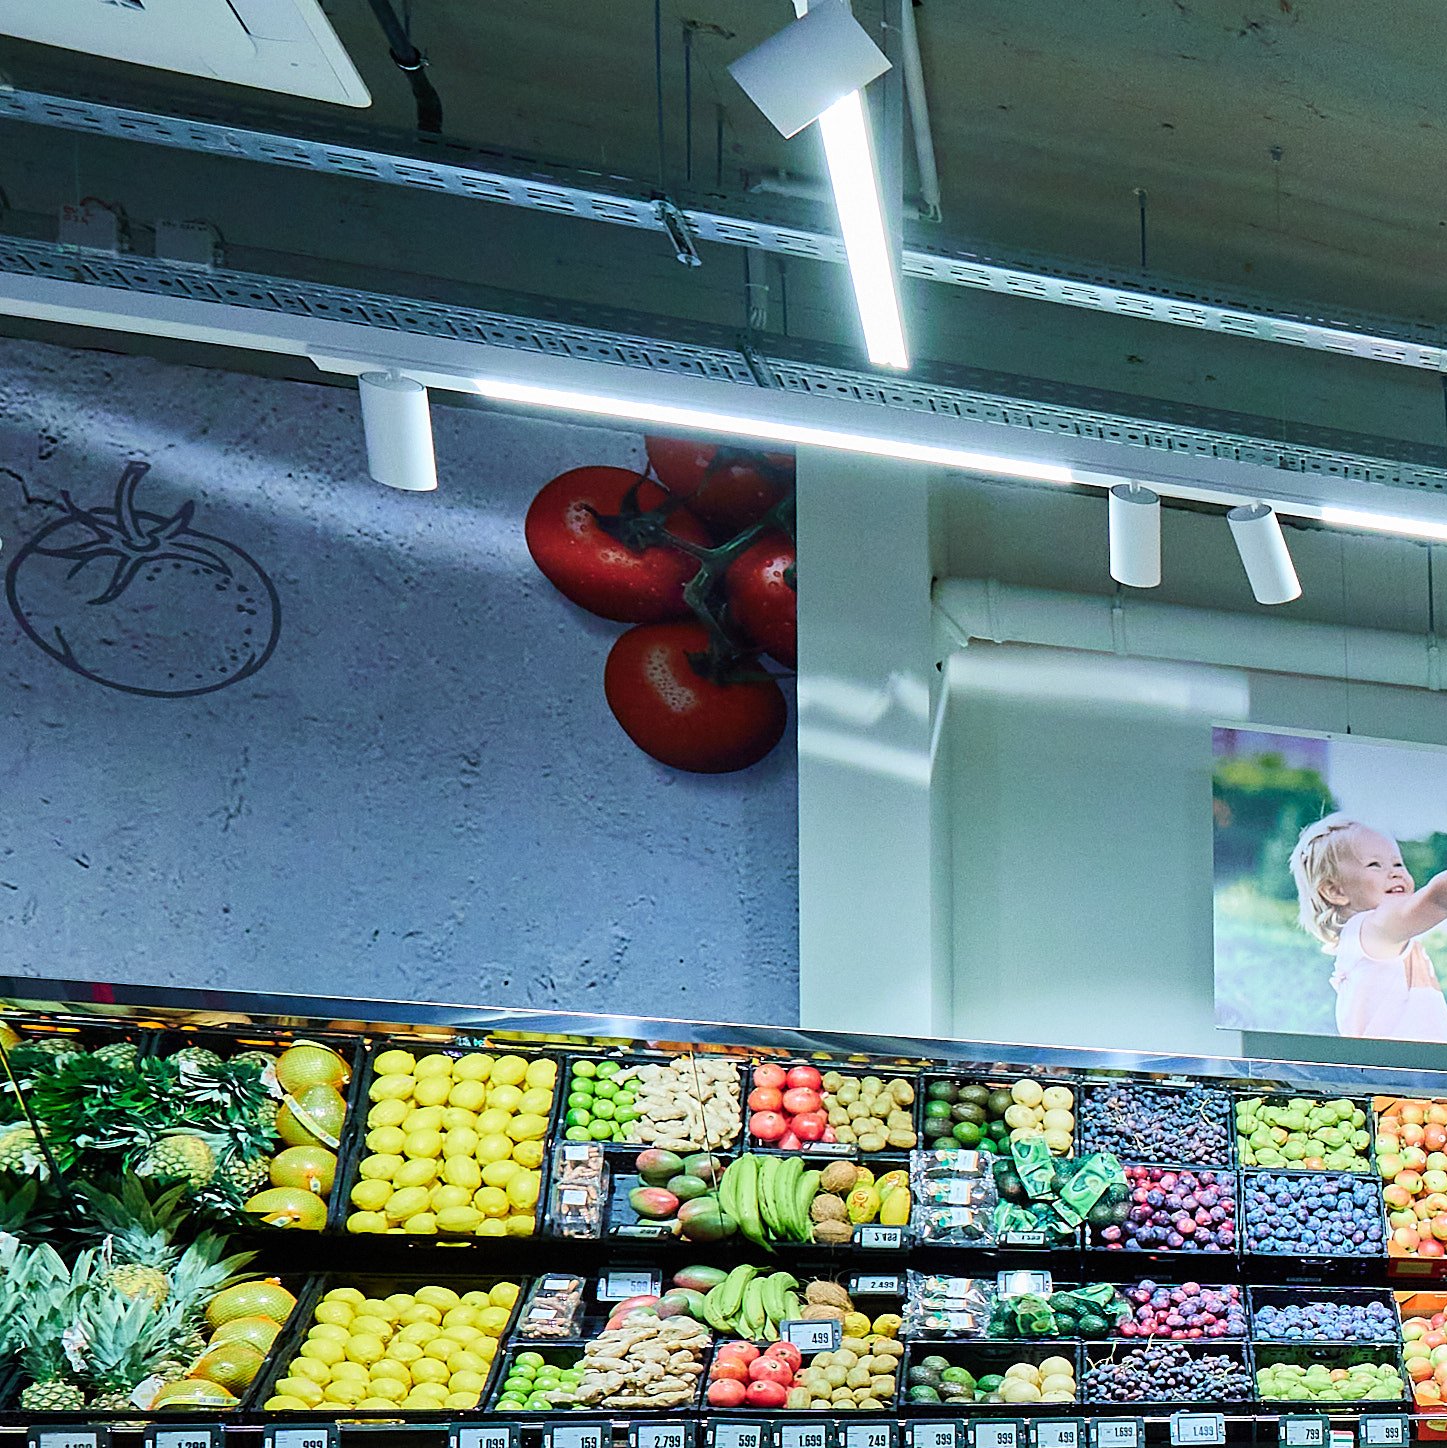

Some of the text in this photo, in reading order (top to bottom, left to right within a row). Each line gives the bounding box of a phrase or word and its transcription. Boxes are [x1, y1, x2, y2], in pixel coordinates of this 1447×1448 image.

[631, 1280, 647, 1292] 599
[812, 1333, 829, 1344] 499
[936, 1432, 952, 1444] 399
[997, 1431, 1013, 1444] 999
[1058, 1431, 1074, 1444] 499
[1305, 1428, 1320, 1440] 799
[1385, 1426, 1399, 1438] 999
[580, 1436, 597, 1448] 159
[654, 1435, 681, 1448] 2.799
[738, 1434, 756, 1447] 599
[798, 1434, 822, 1447] 1.699
[868, 1434, 886, 1446] 249
